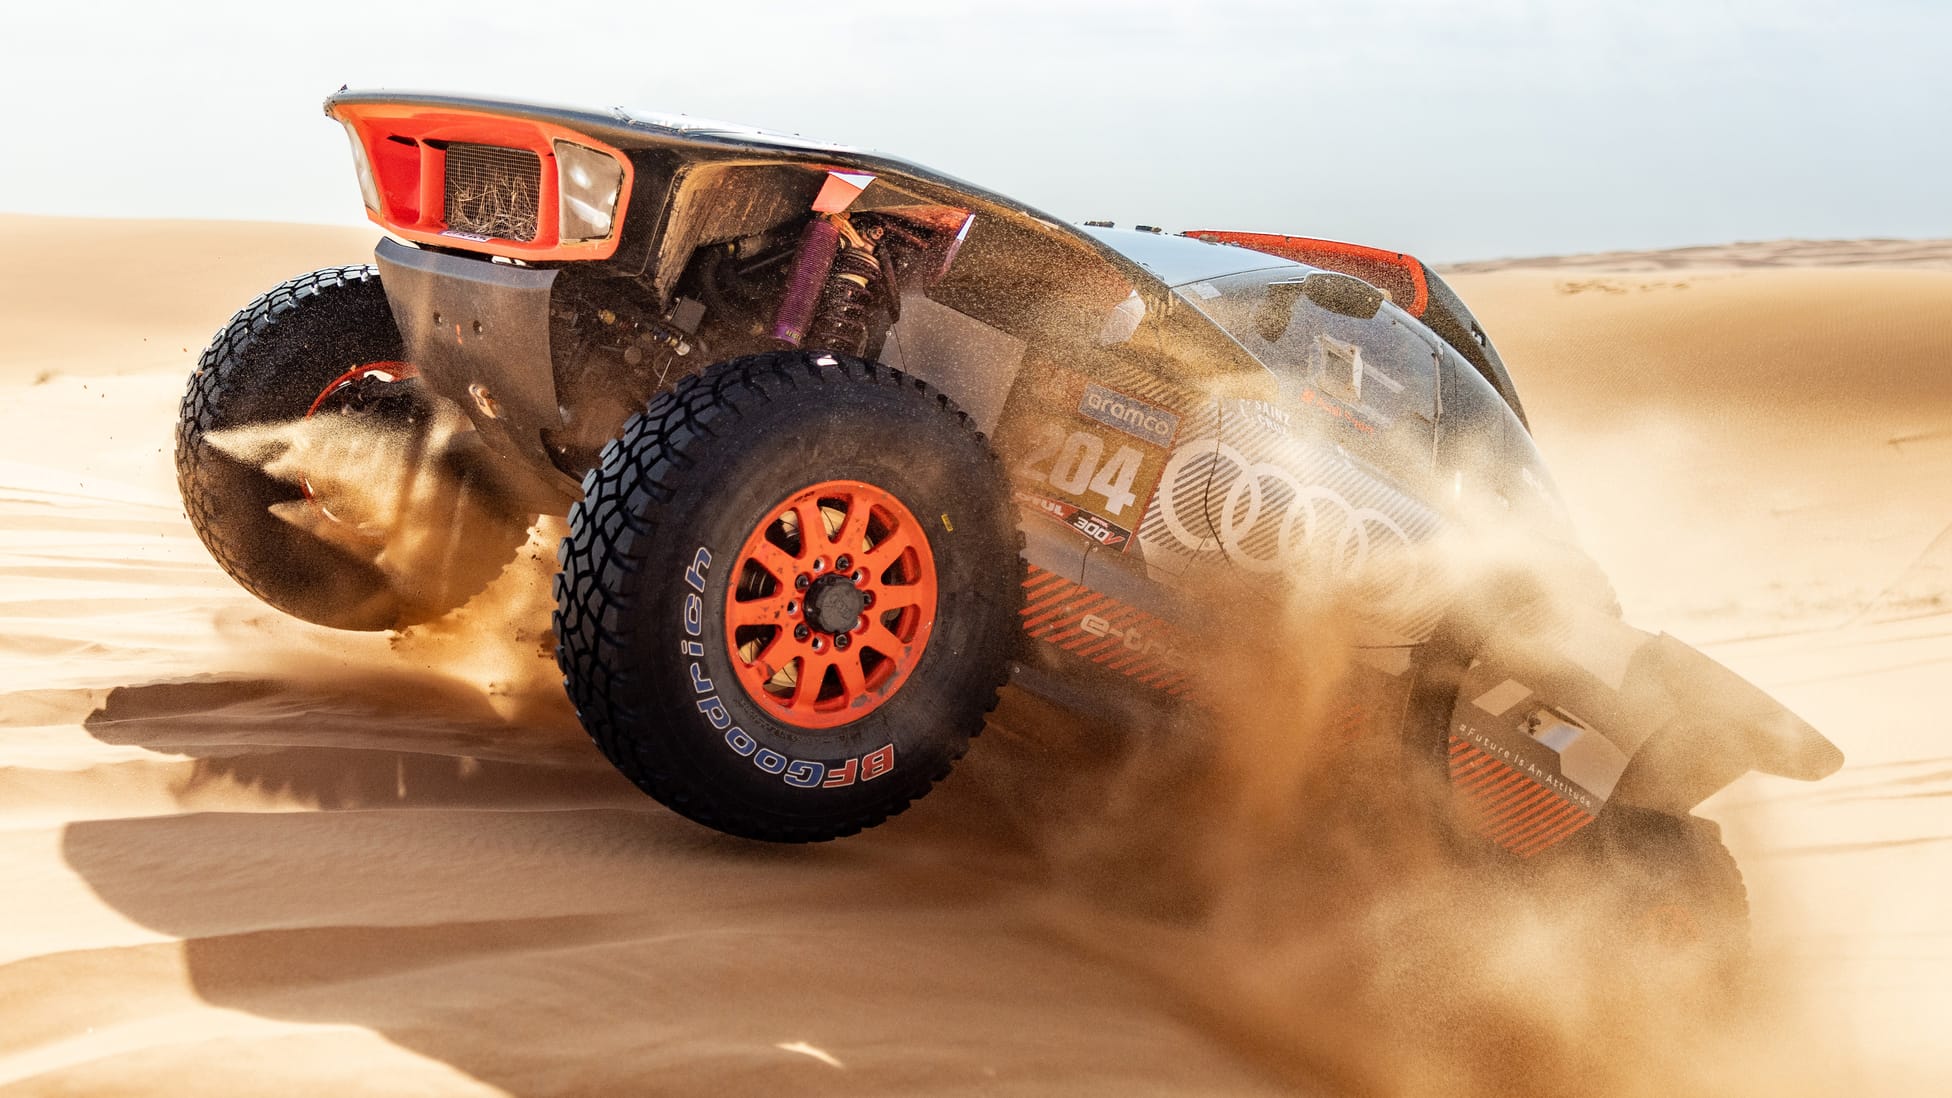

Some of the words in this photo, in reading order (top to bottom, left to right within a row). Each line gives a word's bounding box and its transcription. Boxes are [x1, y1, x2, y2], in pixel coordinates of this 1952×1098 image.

[1088, 394, 1169, 436] aramco
[1252, 399, 1291, 426] SAINZ
[1013, 422, 1145, 516] 204
[1074, 516, 1126, 545] 300V
[681, 546, 895, 789] BFGoodrich
[1459, 723, 1511, 758] #Future
[1527, 763, 1543, 777] An
[1545, 774, 1592, 808] Attitude
